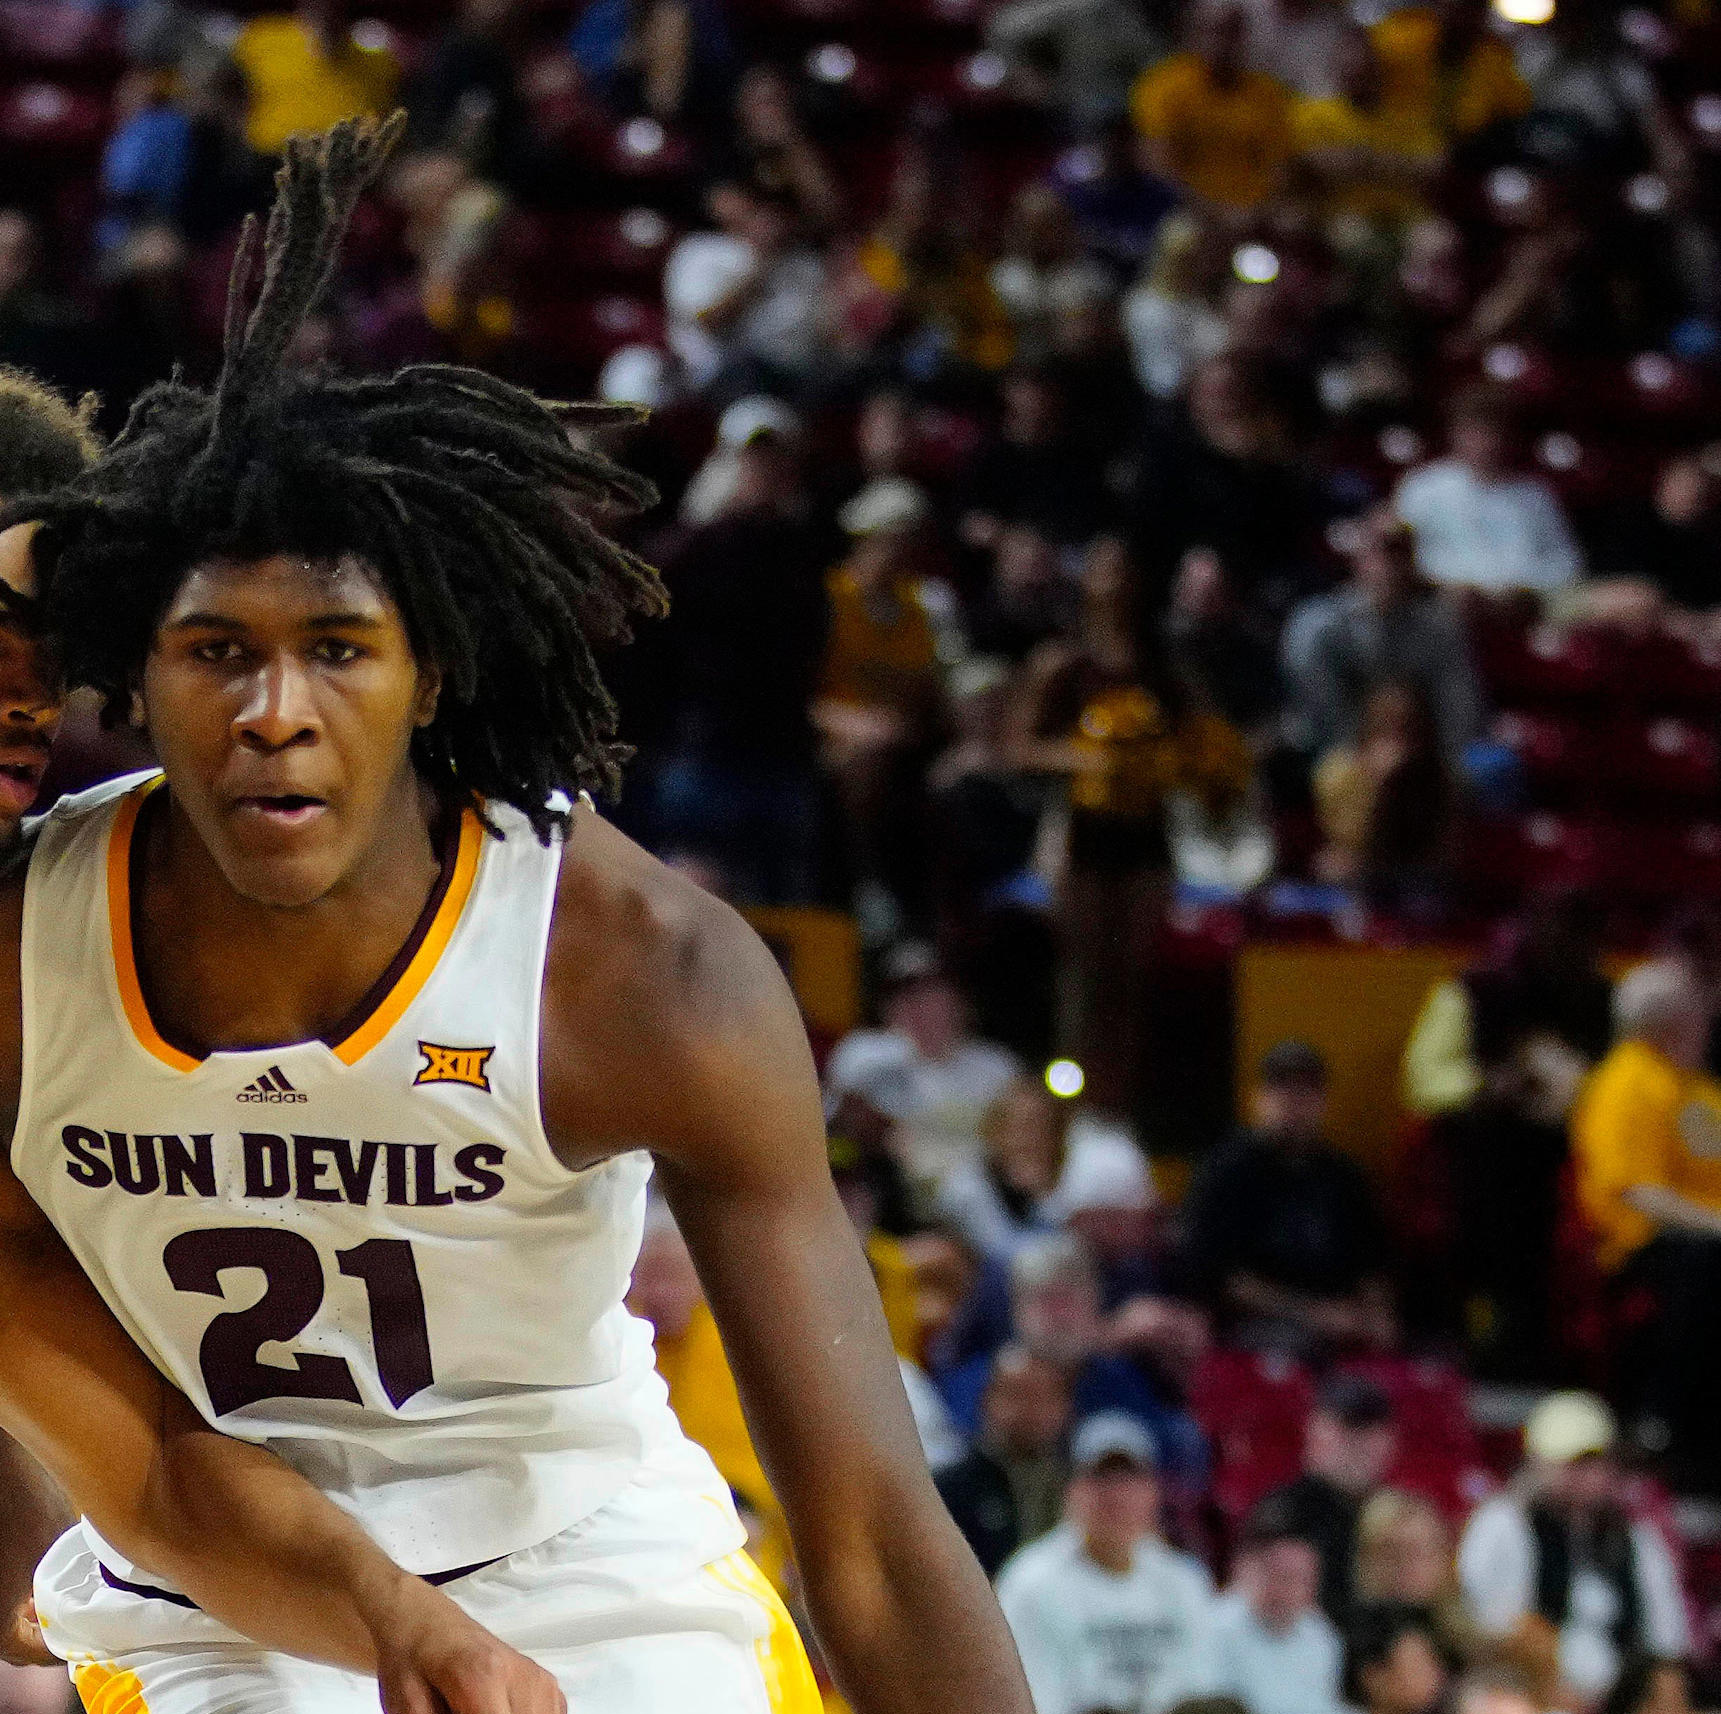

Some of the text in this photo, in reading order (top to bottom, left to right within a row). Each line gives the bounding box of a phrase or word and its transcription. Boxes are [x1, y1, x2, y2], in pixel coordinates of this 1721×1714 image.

[235, 1091, 309, 1105] adidas
[61, 1124, 508, 1207] SUN DEVILS
[162, 1226, 436, 1418] 21
